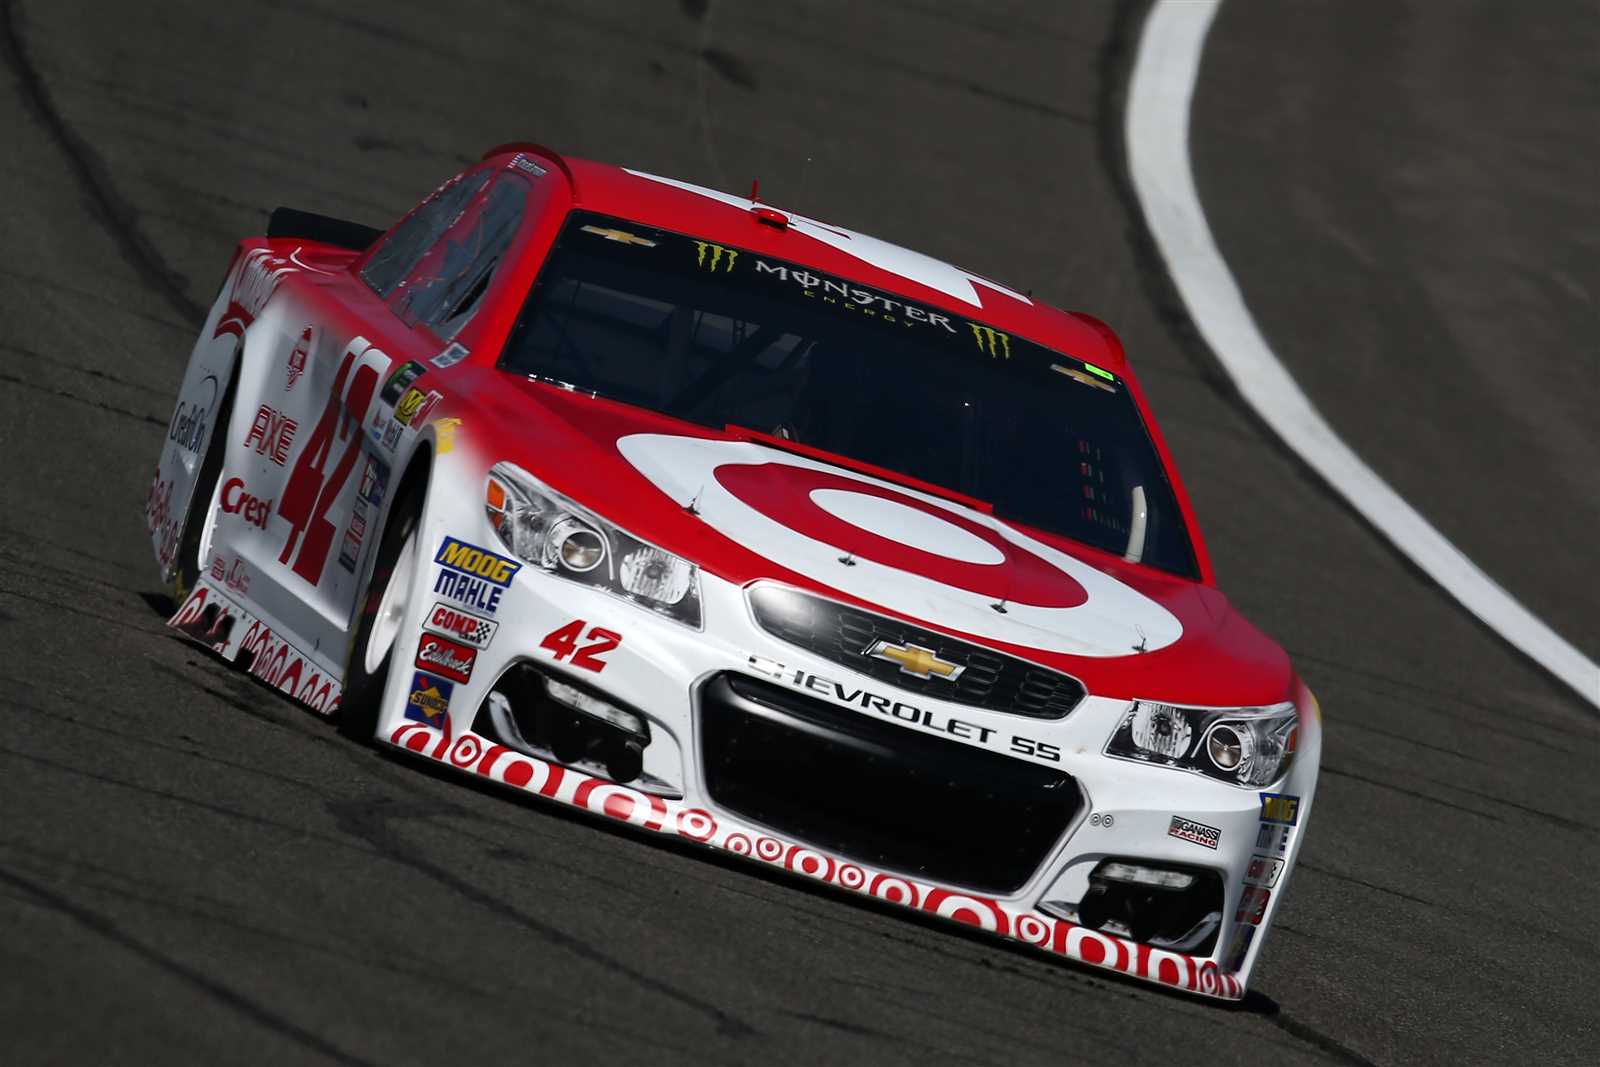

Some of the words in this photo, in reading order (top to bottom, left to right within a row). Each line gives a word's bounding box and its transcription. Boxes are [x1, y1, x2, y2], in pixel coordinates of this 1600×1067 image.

[754, 260, 957, 333] MONSTER
[804, 289, 915, 328] ENERGY
[244, 404, 298, 467] AXE
[220, 477, 273, 531] Crest
[440, 543, 516, 582] MOOG
[434, 567, 501, 613] MAHLE
[432, 607, 478, 634] COMP
[539, 619, 622, 673] 42
[749, 655, 997, 743] CHEVROLET
[1010, 735, 1061, 763] SS
